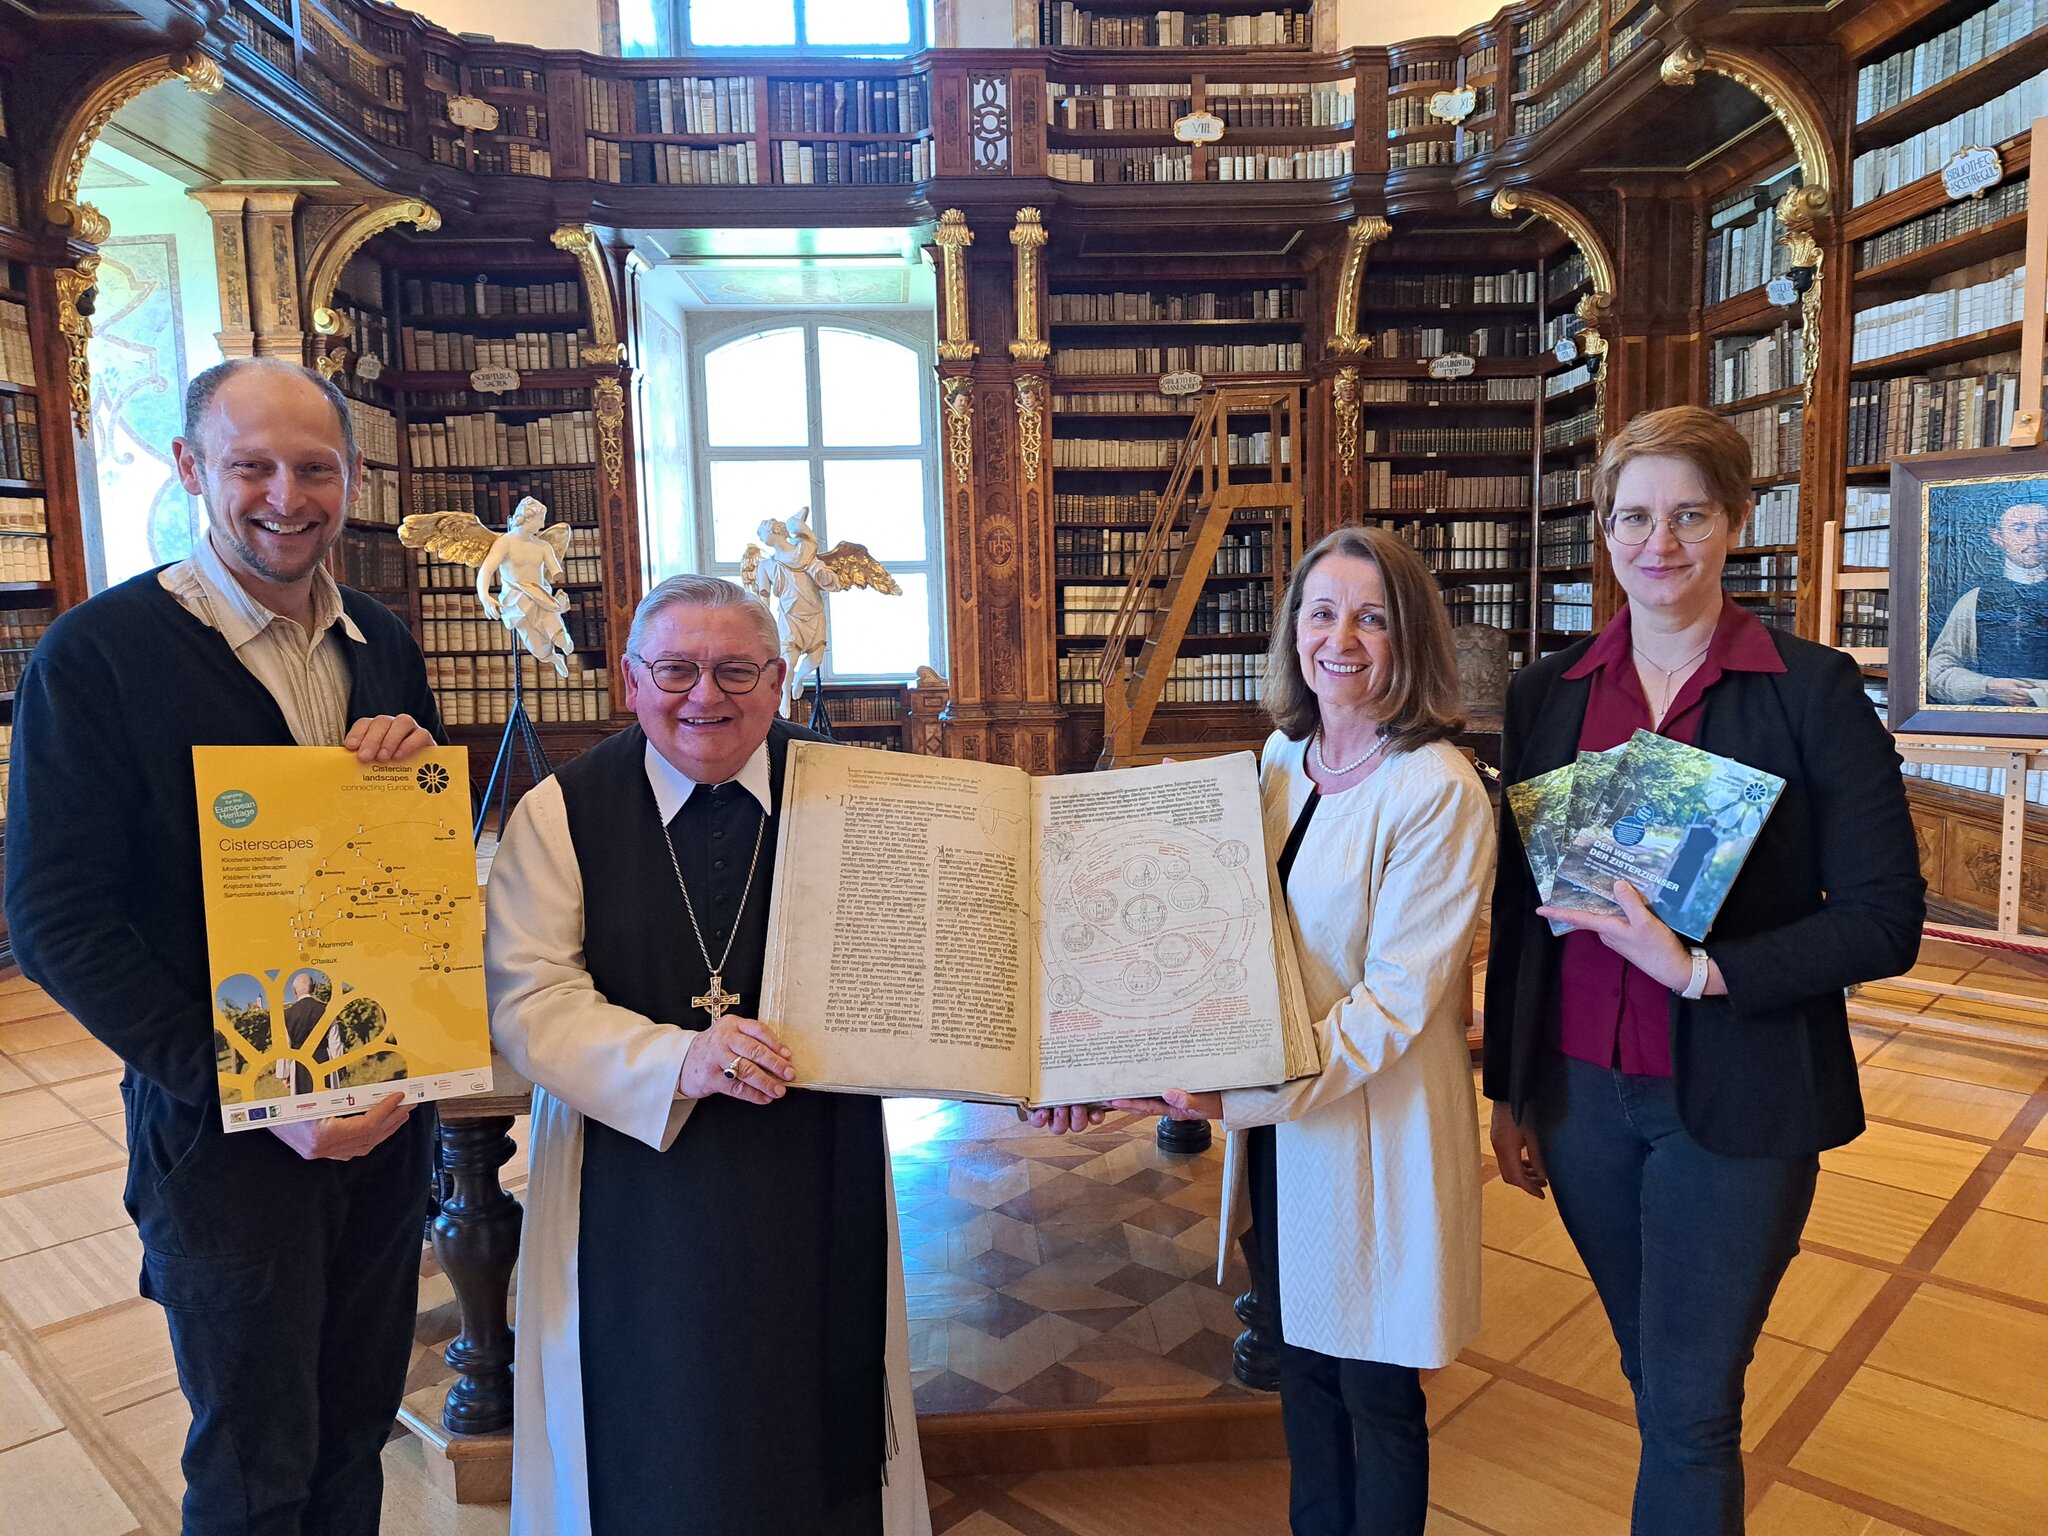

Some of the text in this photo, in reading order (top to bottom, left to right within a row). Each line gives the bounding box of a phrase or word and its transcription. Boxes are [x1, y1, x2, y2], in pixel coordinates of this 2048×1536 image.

[371, 764, 412, 773] Cistercian
[362, 774, 410, 782] landscapes
[341, 783, 415, 792] connecting Europe
[215, 801, 256, 814] European
[219, 809, 255, 820] Heritage
[219, 838, 314, 852] Cisterscapes
[1593, 839, 1636, 863] DER WEG
[221, 855, 284, 863] Klosterlandschaften
[251, 864, 288, 872] landscapes
[1588, 847, 1609, 862] DER
[1608, 856, 1680, 893] ZISTERZIENSER
[223, 889, 295, 899] Samostanska pokrajina
